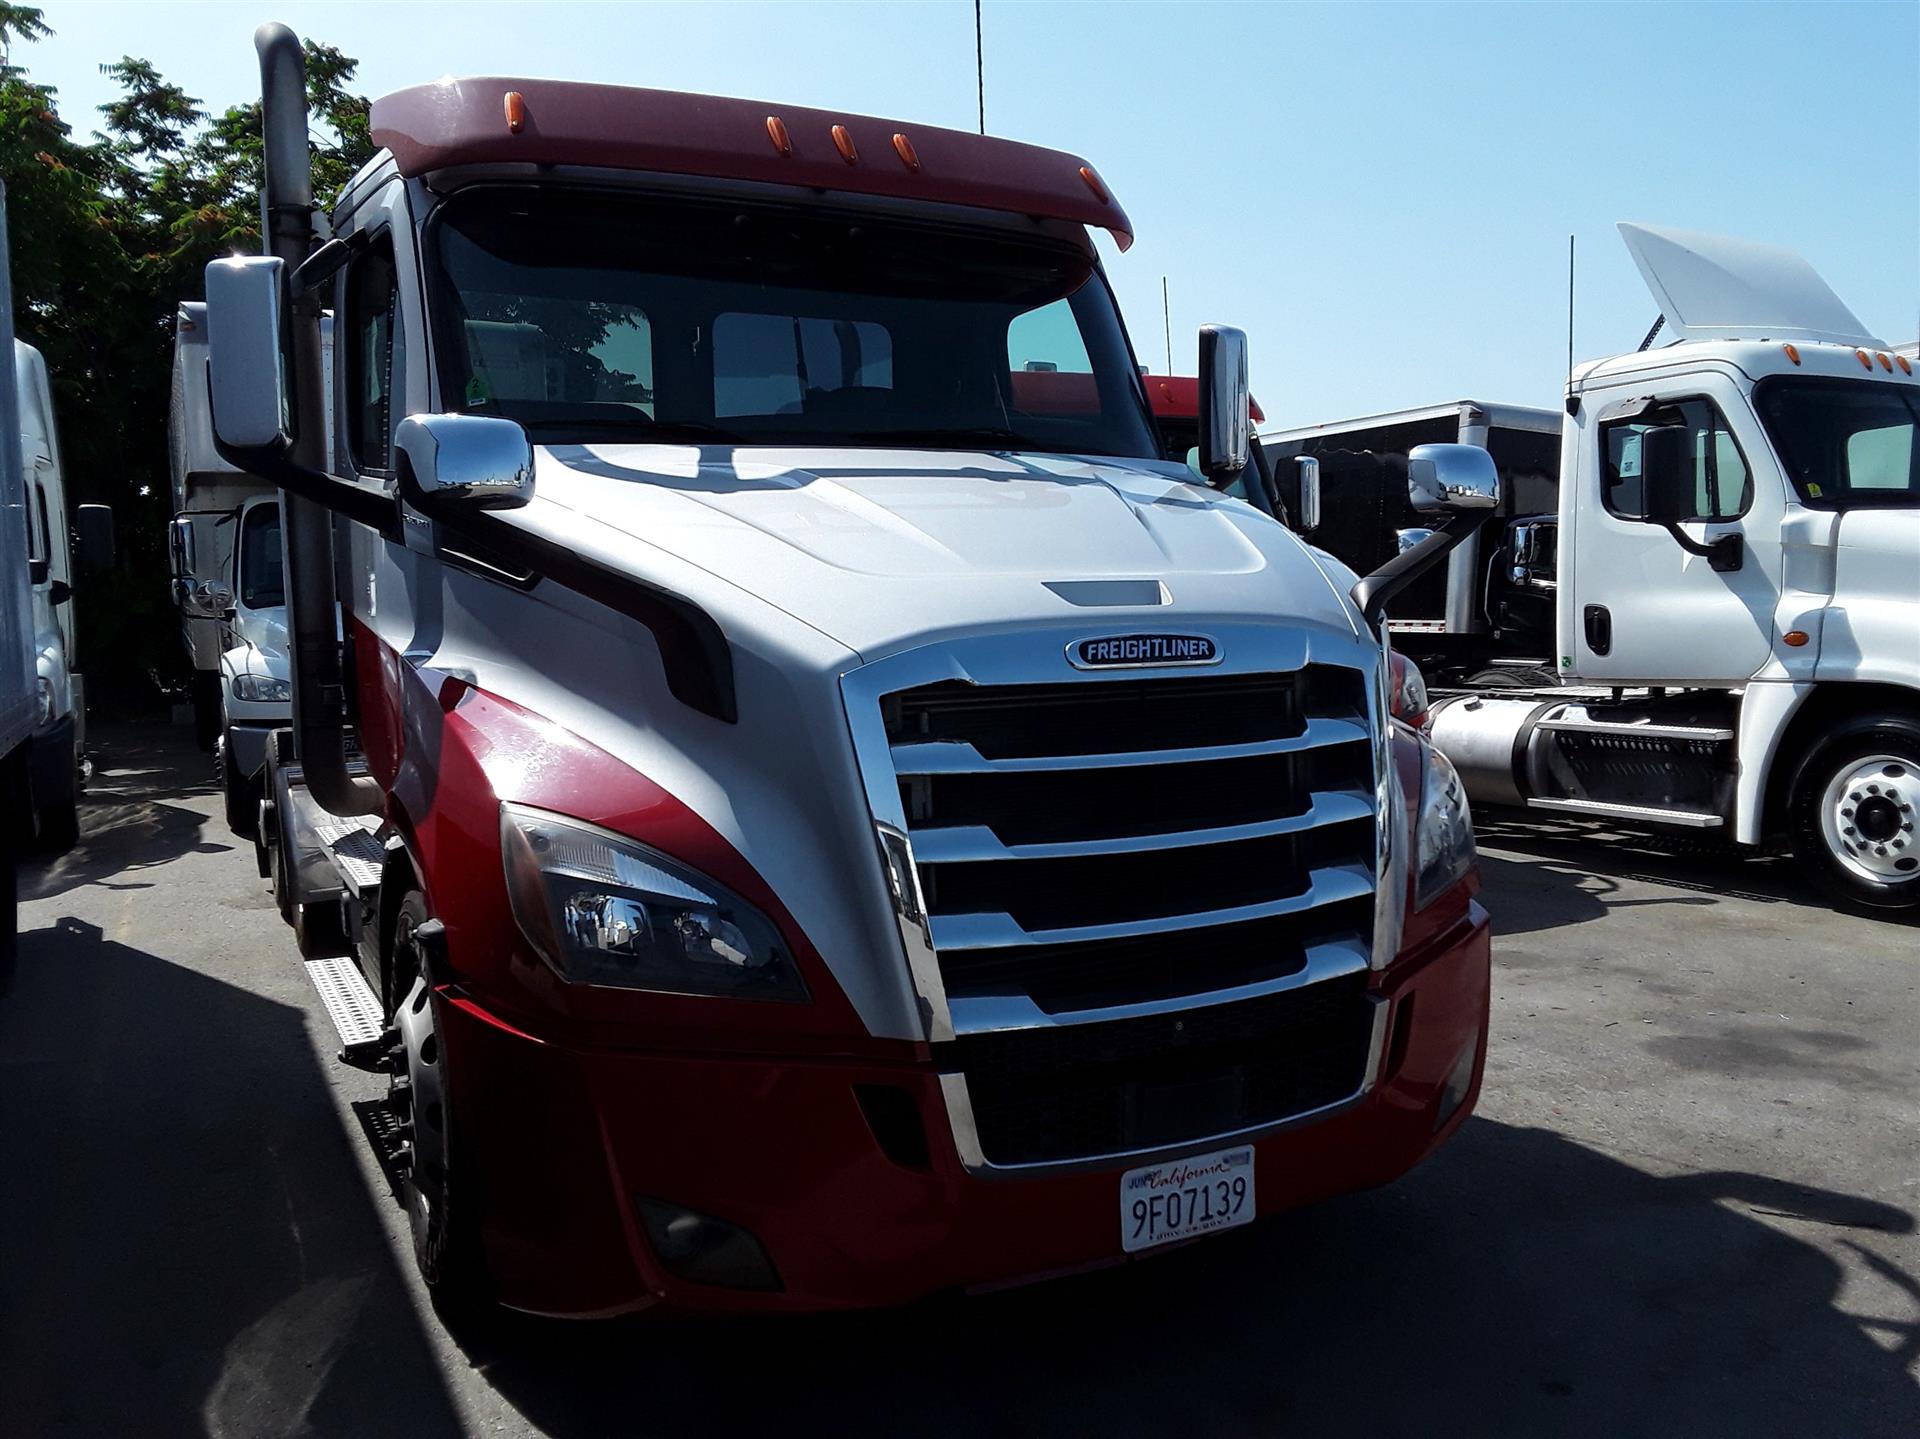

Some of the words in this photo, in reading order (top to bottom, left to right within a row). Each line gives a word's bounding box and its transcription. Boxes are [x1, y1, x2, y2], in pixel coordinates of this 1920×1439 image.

[1087, 639, 1210, 660] FREIGHTLINER
[1150, 1163, 1231, 1189] California
[1132, 1176, 1247, 1239] 9F07139
